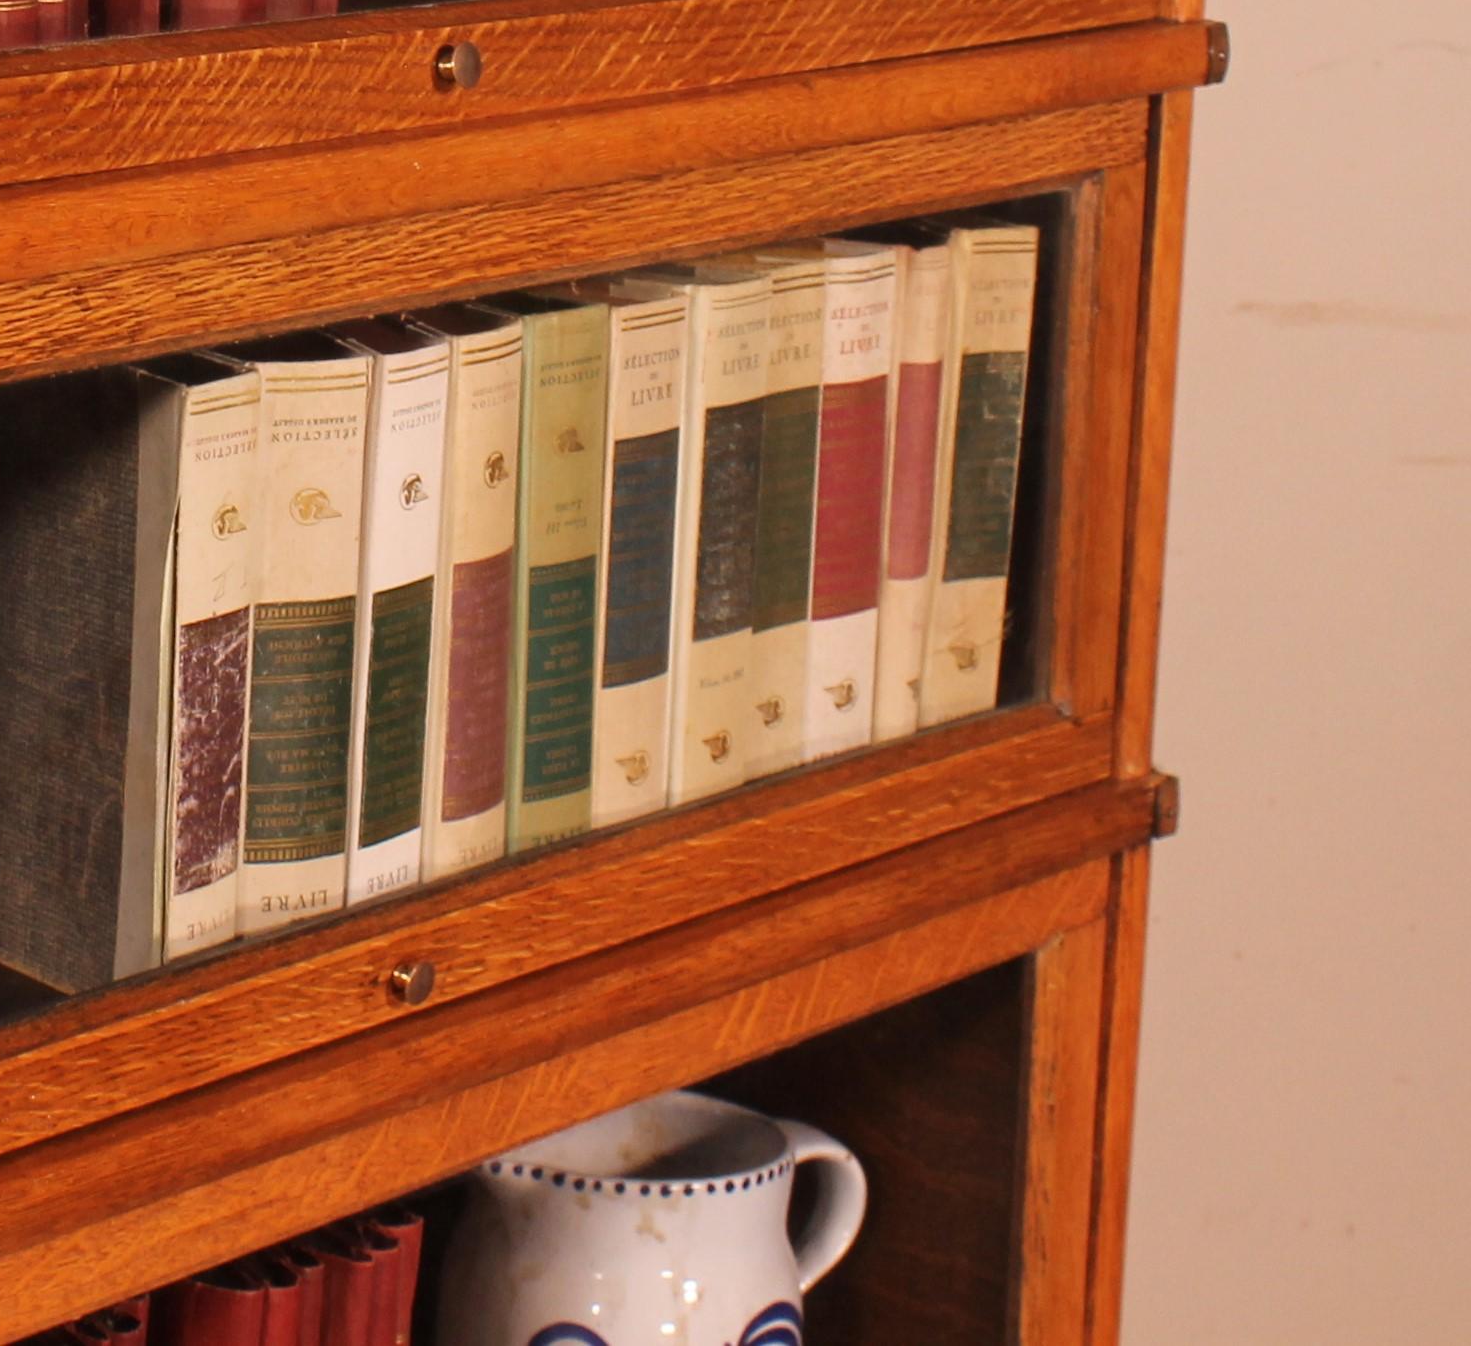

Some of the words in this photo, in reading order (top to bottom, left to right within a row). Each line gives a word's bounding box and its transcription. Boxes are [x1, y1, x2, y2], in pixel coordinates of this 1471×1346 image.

[631, 382, 673, 407] LIVRE
[271, 427, 358, 444] SÉLECTION
[366, 865, 409, 895] LIVRE
[261, 889, 328, 912] LIVRE
